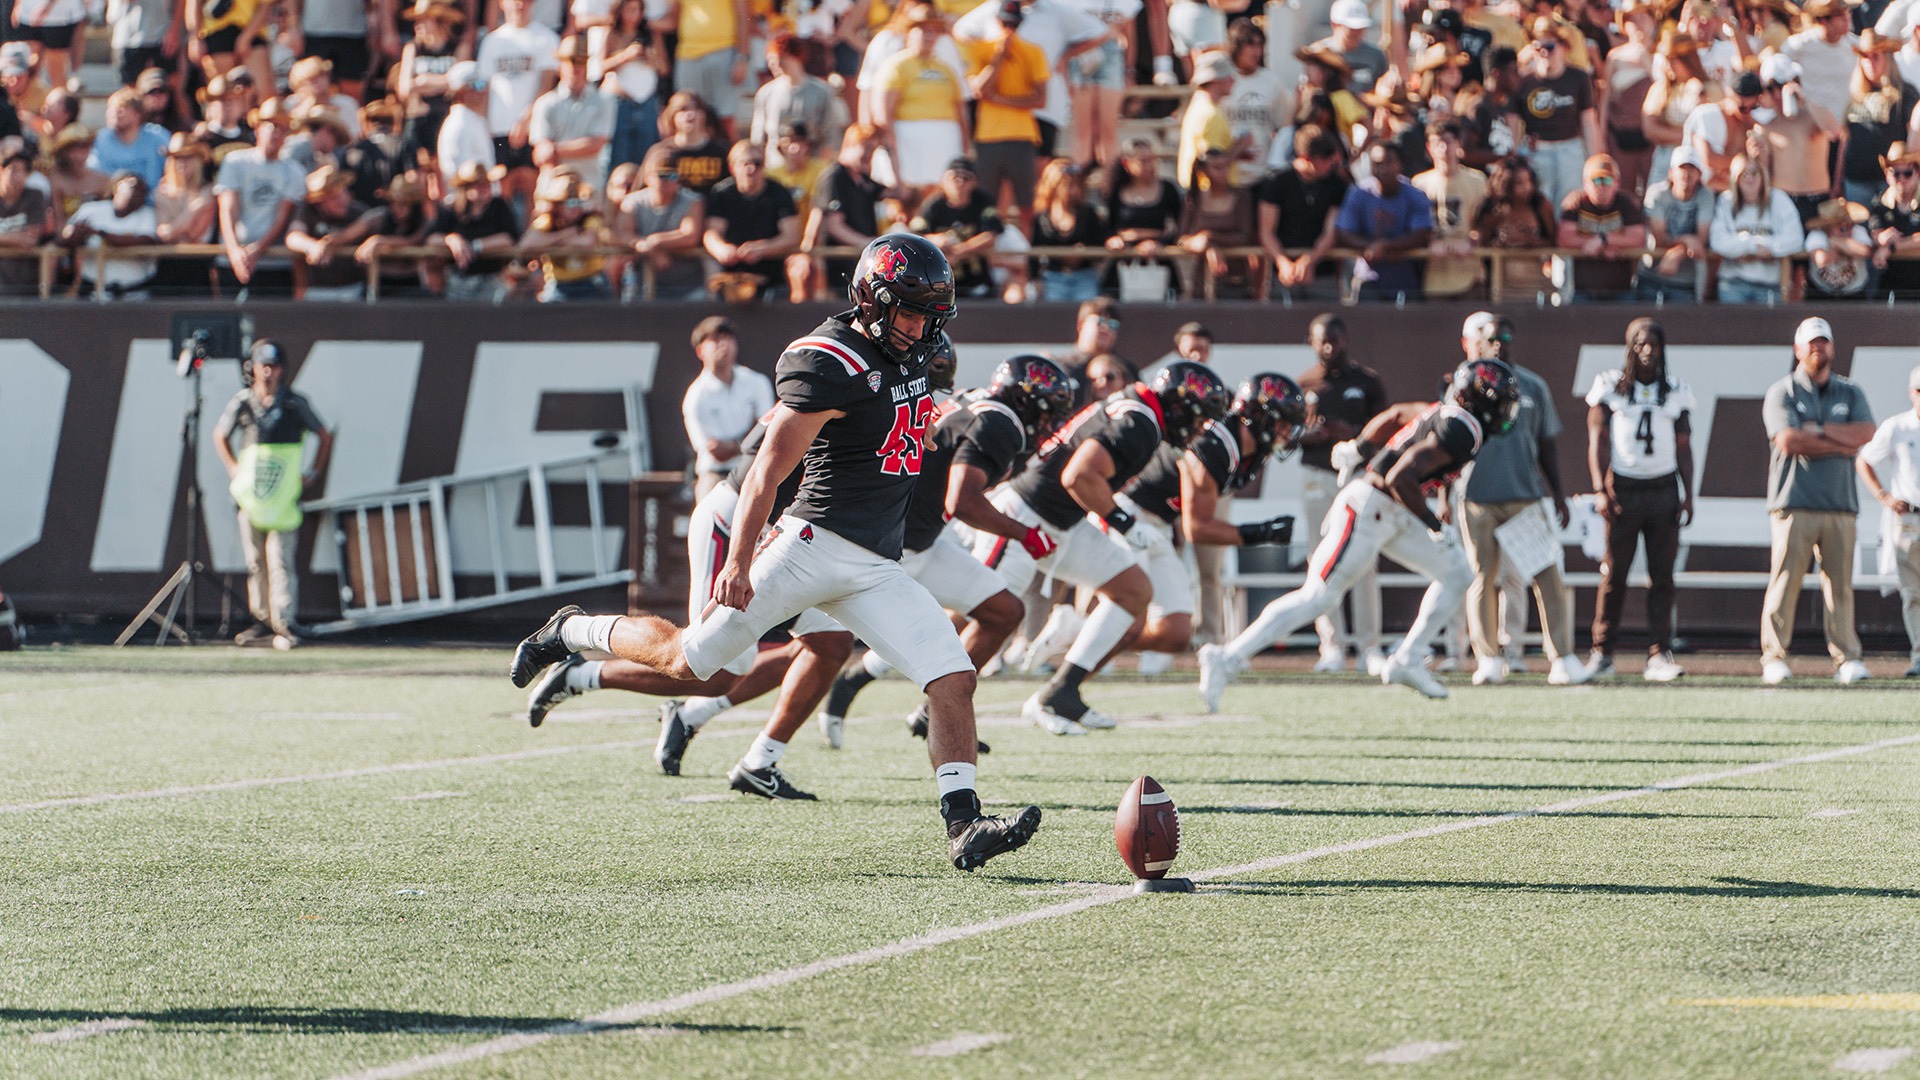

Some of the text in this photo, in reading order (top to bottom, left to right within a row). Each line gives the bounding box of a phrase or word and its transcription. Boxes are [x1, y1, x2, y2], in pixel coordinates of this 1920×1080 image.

[890, 384, 908, 402] BALL
[908, 377, 927, 396] STATE
[876, 394, 933, 475] 43
[1635, 411, 1654, 455] 4
